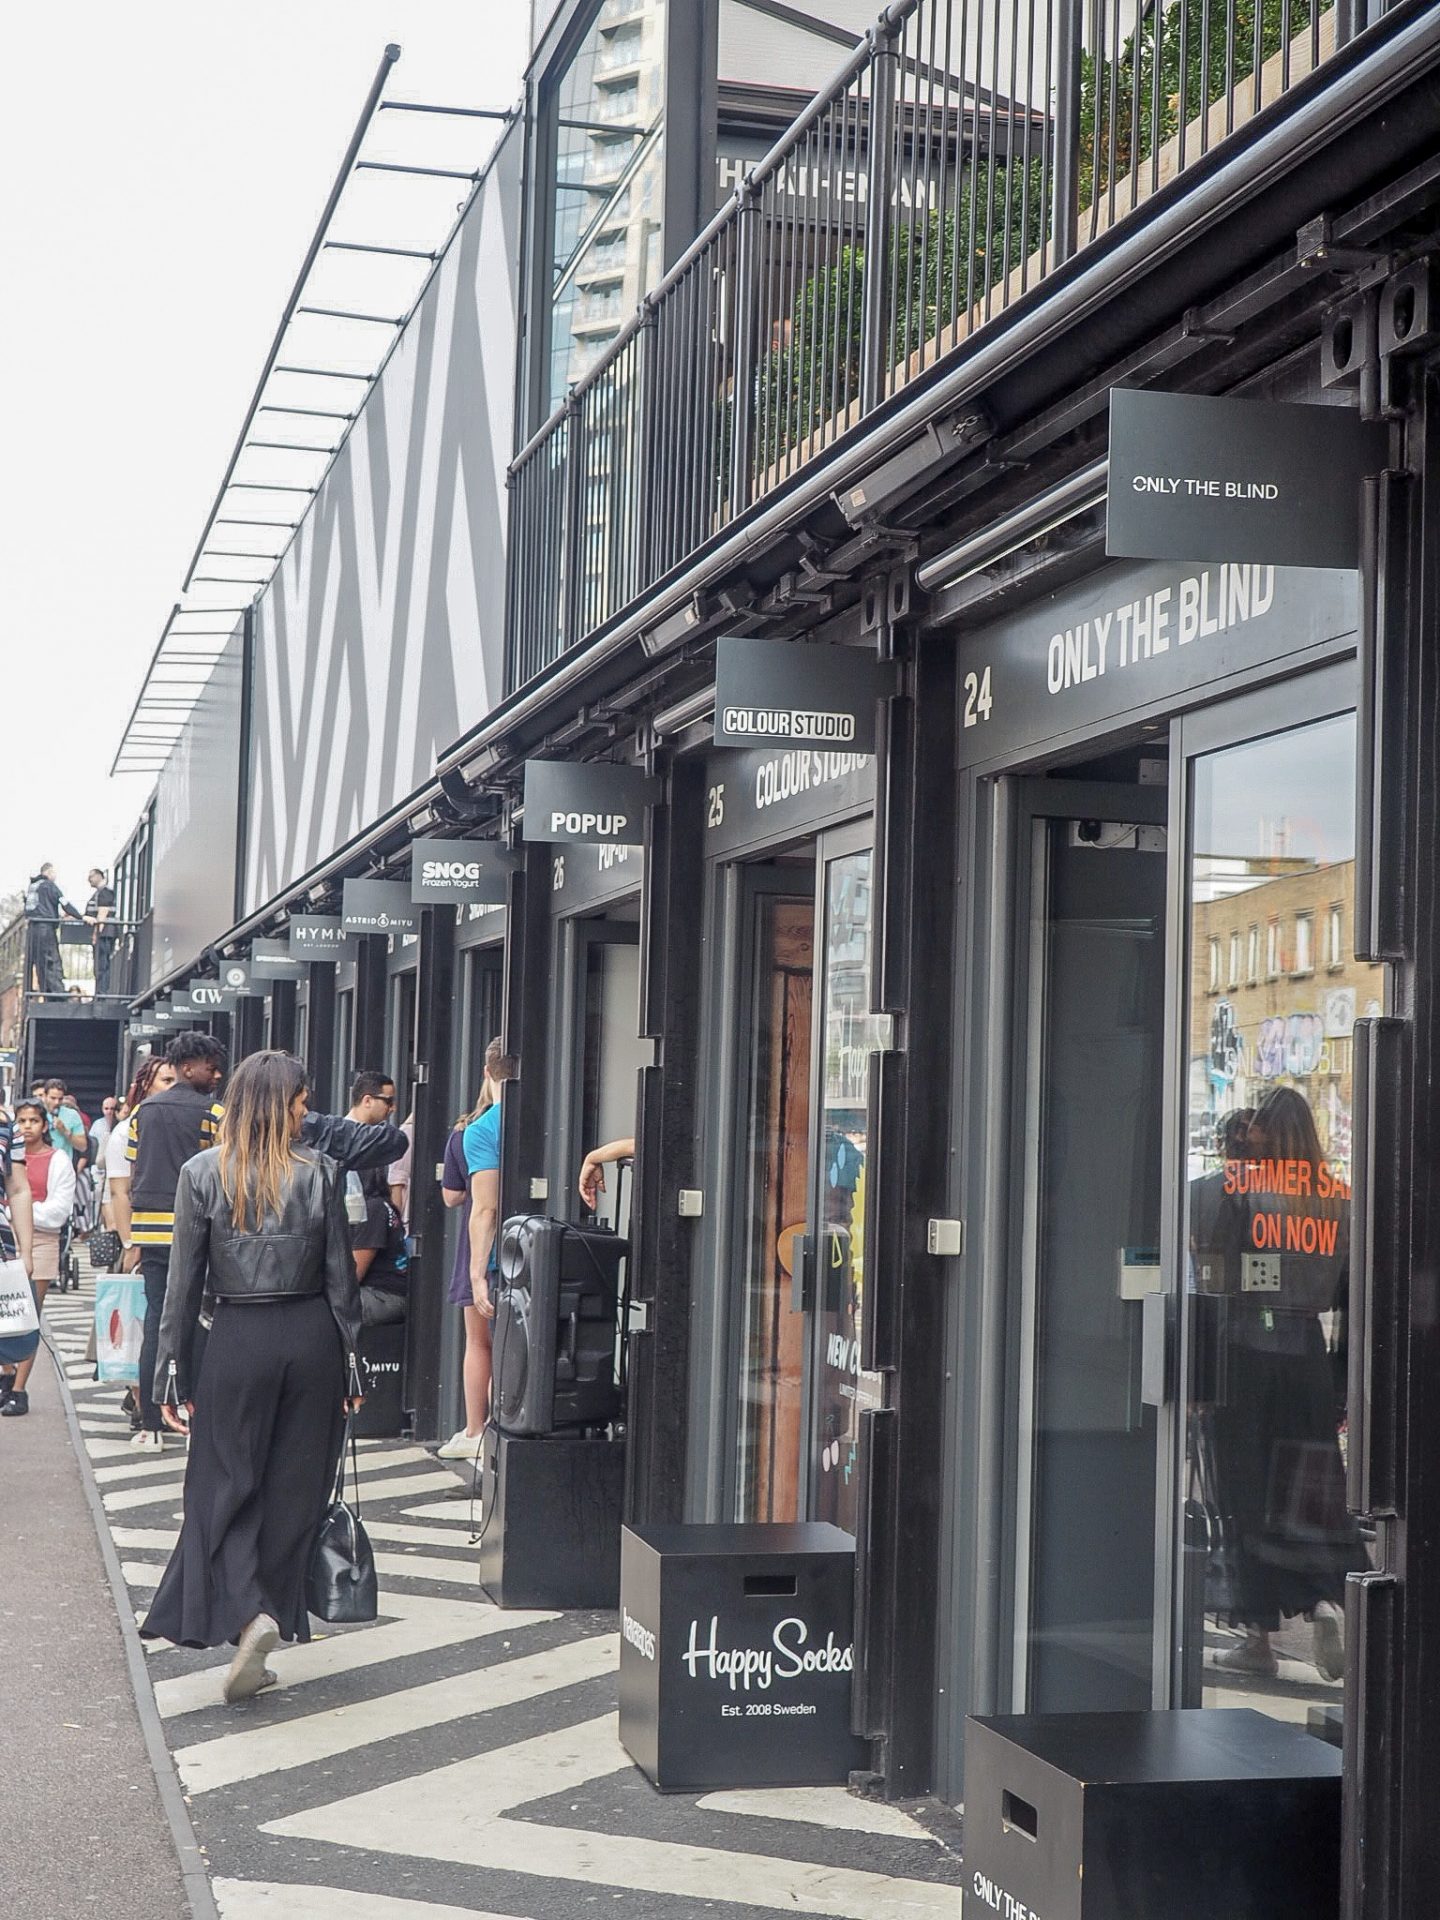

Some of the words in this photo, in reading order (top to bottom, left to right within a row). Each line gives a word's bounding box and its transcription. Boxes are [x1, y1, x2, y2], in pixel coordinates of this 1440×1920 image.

[1132, 474, 1181, 495] ONLY
[1184, 479, 1221, 497] THE
[1224, 482, 1279, 501] BLIND
[1047, 612, 1112, 695] ONLY
[1116, 587, 1171, 668] THE
[1178, 564, 1275, 645] BLIND
[963, 666, 993, 728] 24
[726, 710, 790, 735] COLOUR
[794, 714, 852, 738] STUDIO
[755, 751, 811, 810] COLOUR
[812, 751, 867, 787] STU
[708, 784, 725, 828] 25
[551, 812, 628, 836] POPUP
[421, 878, 451, 887] Frozen
[452, 879, 480, 889] Yogurt
[422, 861, 480, 879] SNOG
[553, 856, 565, 891] 26
[296, 927, 346, 941] HYMN
[345, 915, 377, 925] ASTRID
[390, 919, 413, 927] MIYU
[1224, 1158, 1311, 1197] SUMMER
[1252, 1212, 1281, 1249] ON
[1286, 1215, 1338, 1257] NOW
[371, 1362, 400, 1373] MIYU
[827, 1333, 850, 1371] NEW
[682, 1616, 772, 1691] Happy
[772, 1617, 853, 1679] Socks
[721, 1704, 744, 1717] Est.
[746, 1704, 772, 1717] 2008
[773, 1703, 816, 1716] Sweden
[973, 1871, 1003, 1911] ONLY
[1003, 1892, 1028, 1920] THE
